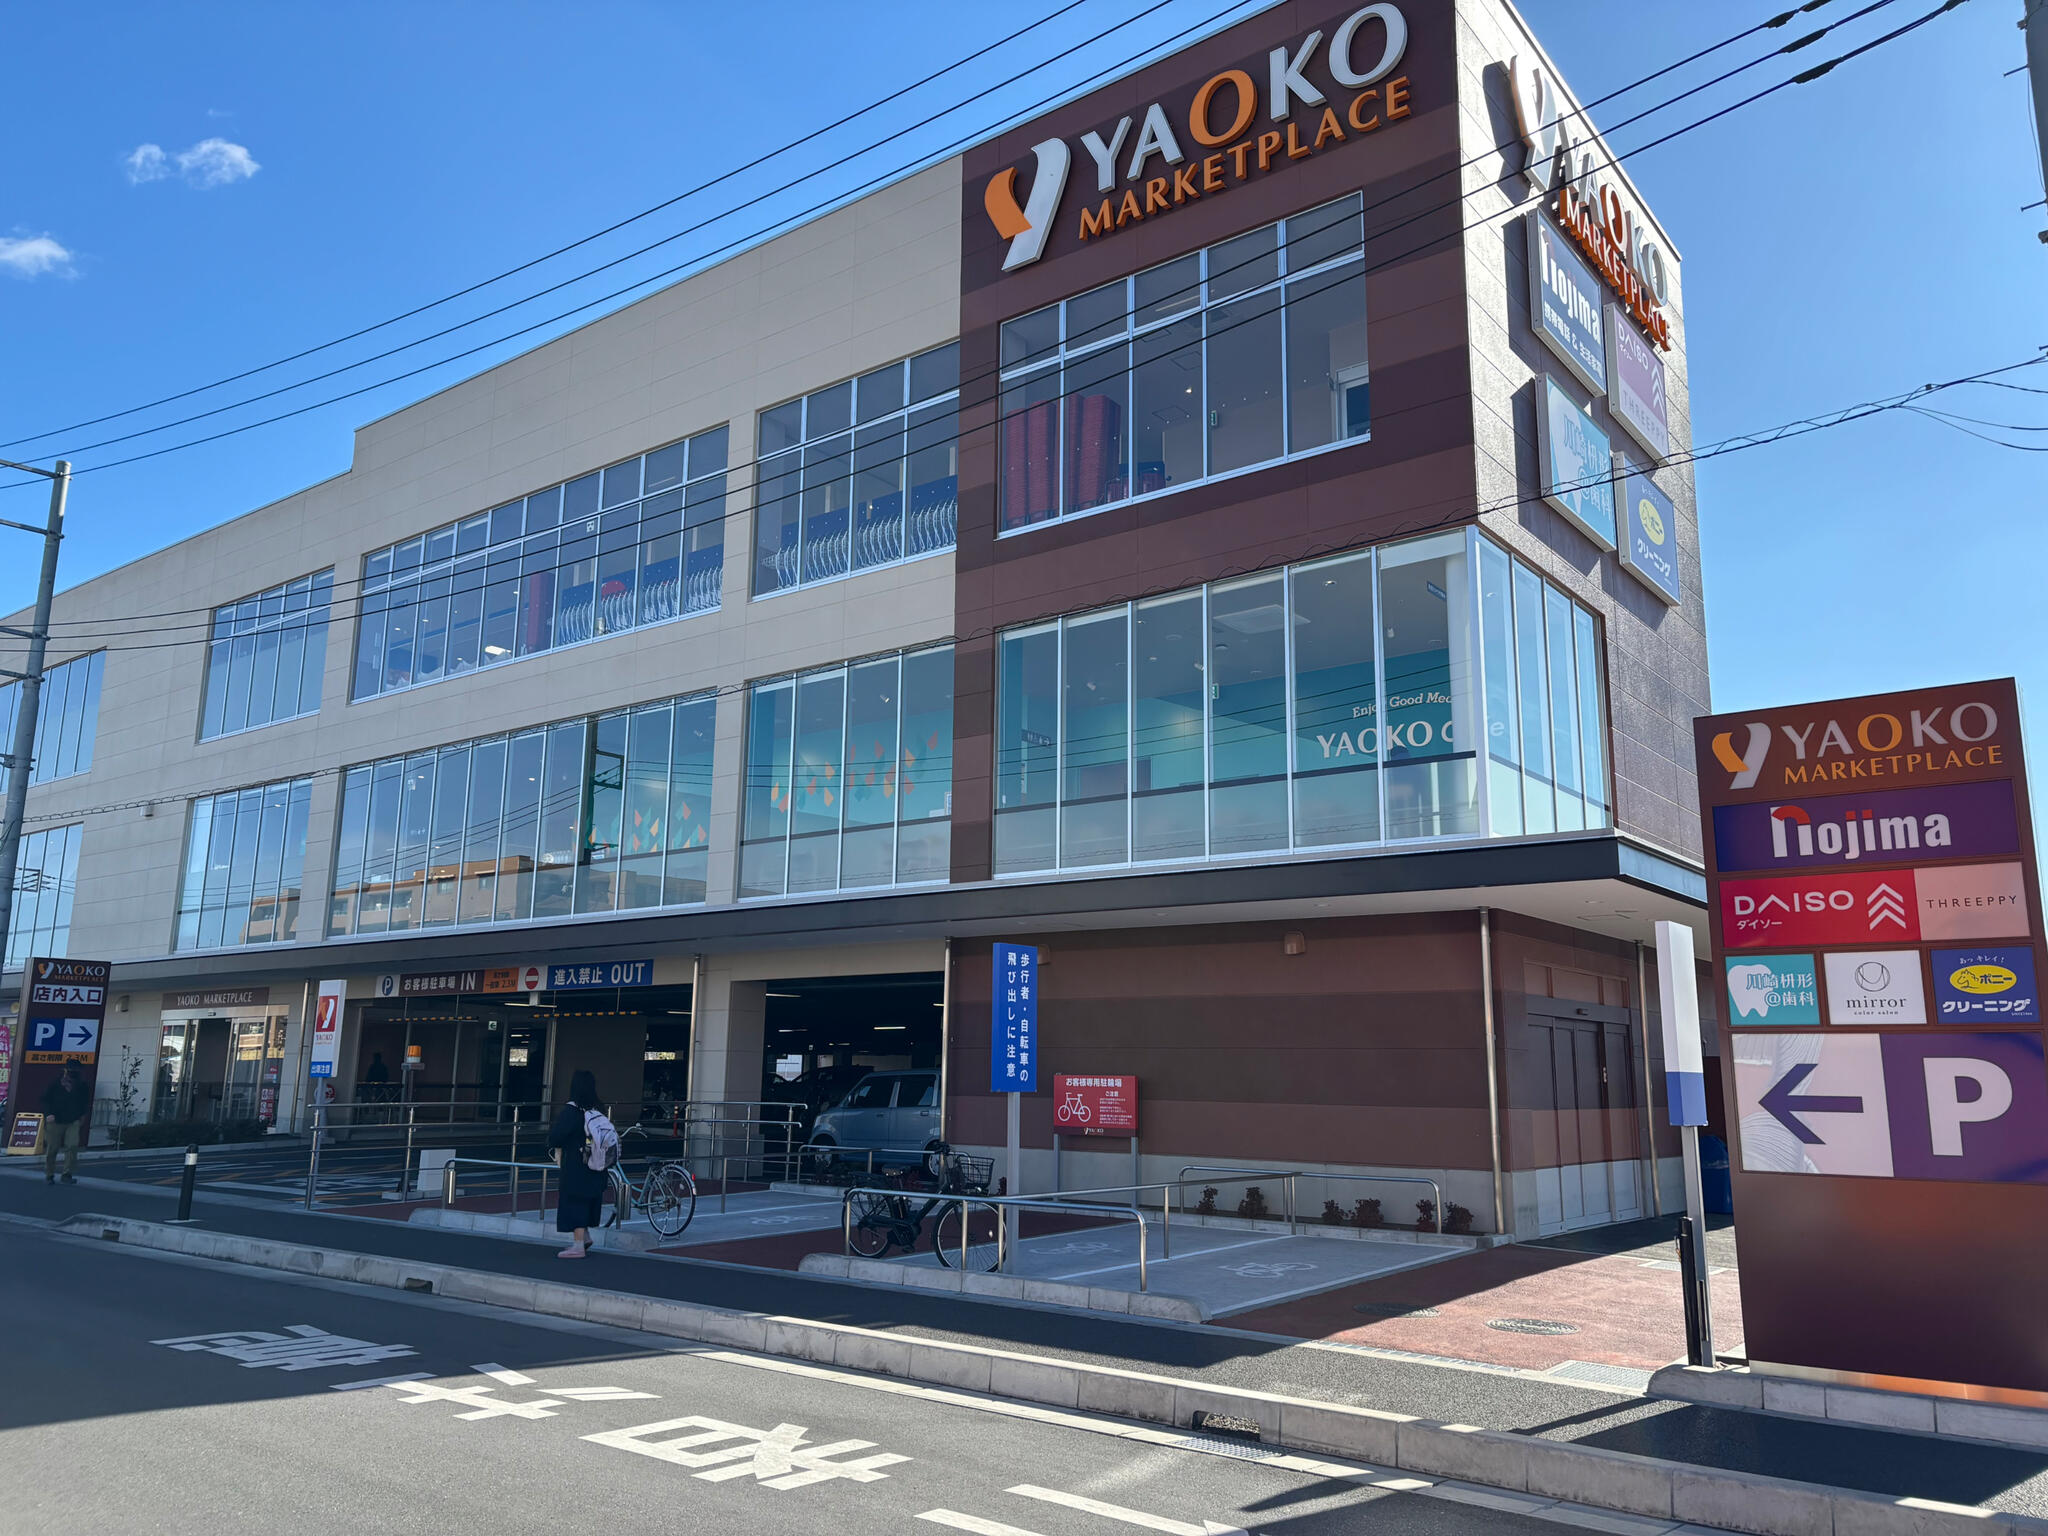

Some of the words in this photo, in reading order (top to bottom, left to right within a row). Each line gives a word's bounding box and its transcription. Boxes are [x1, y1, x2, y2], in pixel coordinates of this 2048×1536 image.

[1080, 3, 1408, 194] YAOKO
[1079, 76, 1412, 241] MARKETPLACE
[1558, 113, 1668, 308] YAOKO
[1539, 223, 1602, 346] nojima
[1617, 320, 1649, 371] DAISO
[1352, 703, 1378, 719] Enjo
[1390, 692, 1423, 708] Good
[1316, 720, 1433, 759] YAOKO
[1781, 702, 1999, 760] YAOKO
[1784, 745, 2003, 785] MARKETPLACE
[1770, 805, 1952, 860] nojima
[1734, 890, 1855, 916] DAISO
[1926, 895, 2018, 909] THREEPPY
[1736, 919, 1783, 930] ダイソー
[55, 963, 105, 978] YAOKO
[460, 972, 476, 991] IN
[554, 966, 602, 986] 進入禁止
[611, 962, 645, 984] OUT
[1979, 973, 2013, 986] ポニー
[35, 986, 102, 1003] 店内入口
[177, 993, 200, 1007] YAOKO
[203, 990, 253, 1006] MARKETPLACE
[1764, 990, 1815, 1008] @歯科
[1846, 995, 1908, 1009] mirror
[1942, 997, 2032, 1014] クリーニング
[1007, 952, 1016, 1077] 飛び出しに注意
[1020, 954, 1029, 1081] 歩行者・自転車の
[34, 1022, 56, 1047] P
[1922, 1056, 2013, 1157] P
